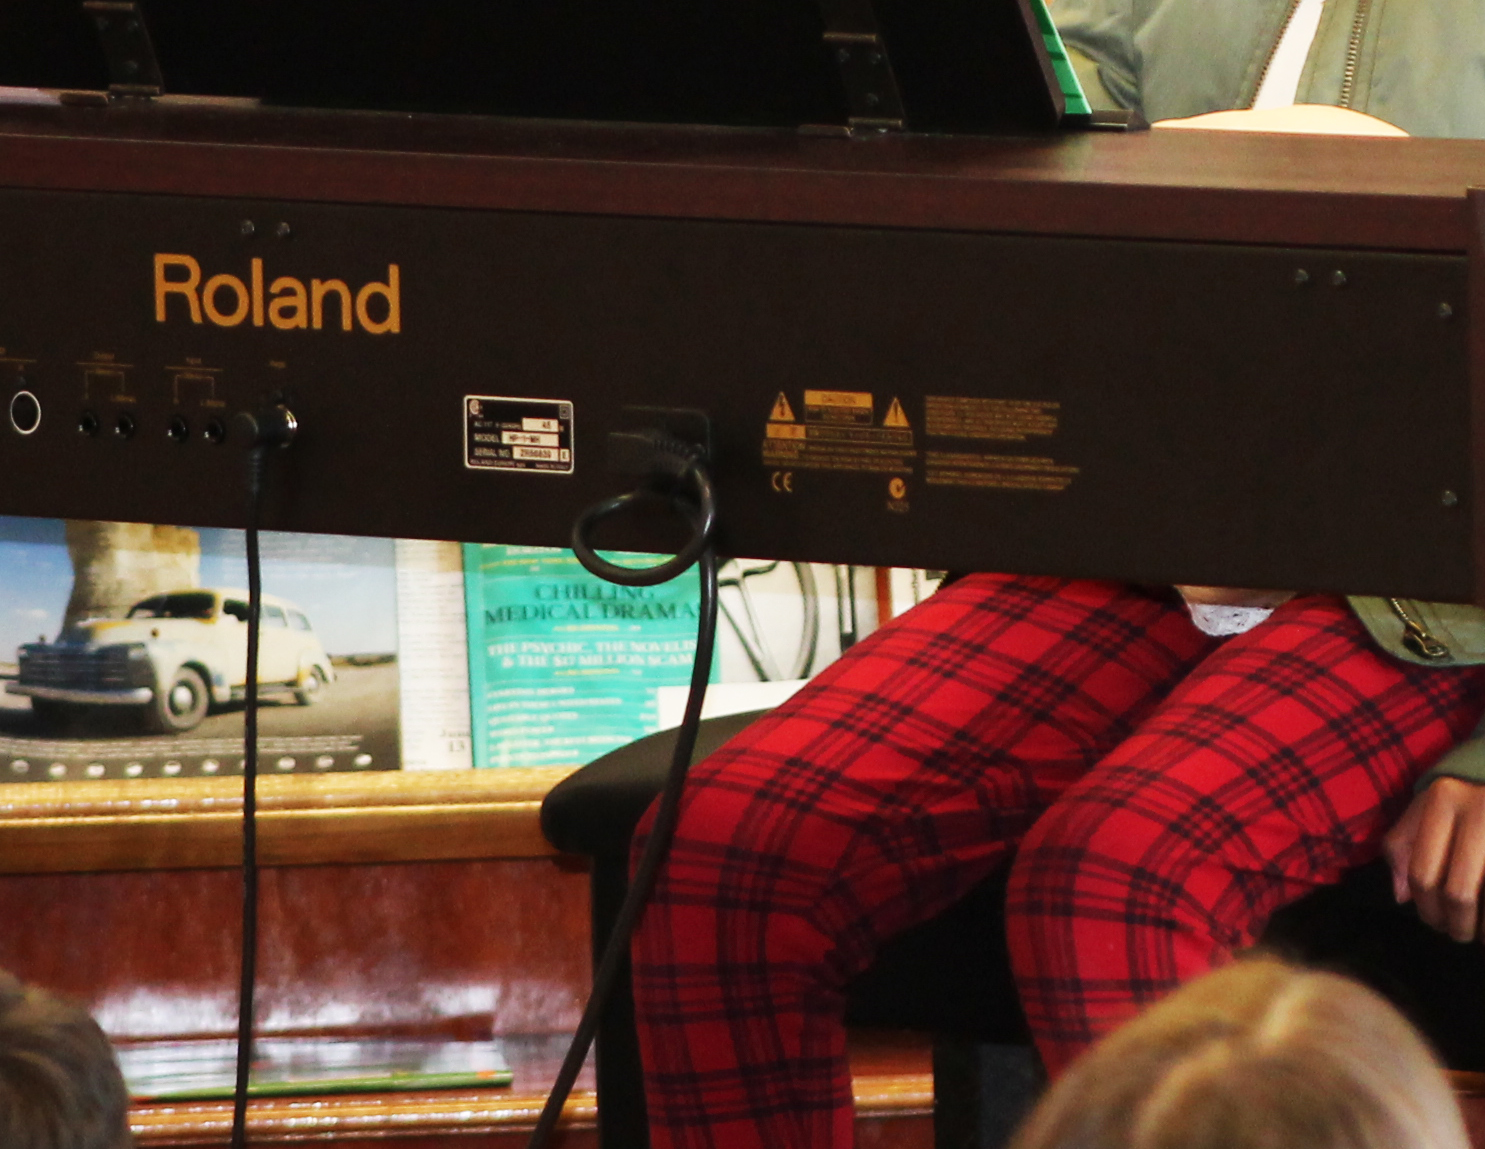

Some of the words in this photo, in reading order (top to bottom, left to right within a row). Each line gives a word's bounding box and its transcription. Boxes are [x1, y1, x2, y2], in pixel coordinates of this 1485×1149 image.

[153, 253, 401, 334] Roland
[535, 584, 655, 600] CHILLING
[485, 603, 596, 624] MEDICAL
[602, 603, 701, 621] DRAMA
[487, 643, 515, 656] THE
[595, 641, 629, 653] THE
[632, 639, 697, 653] NOVELIS
[518, 655, 548, 668] THE
[579, 654, 645, 667] MILLION
